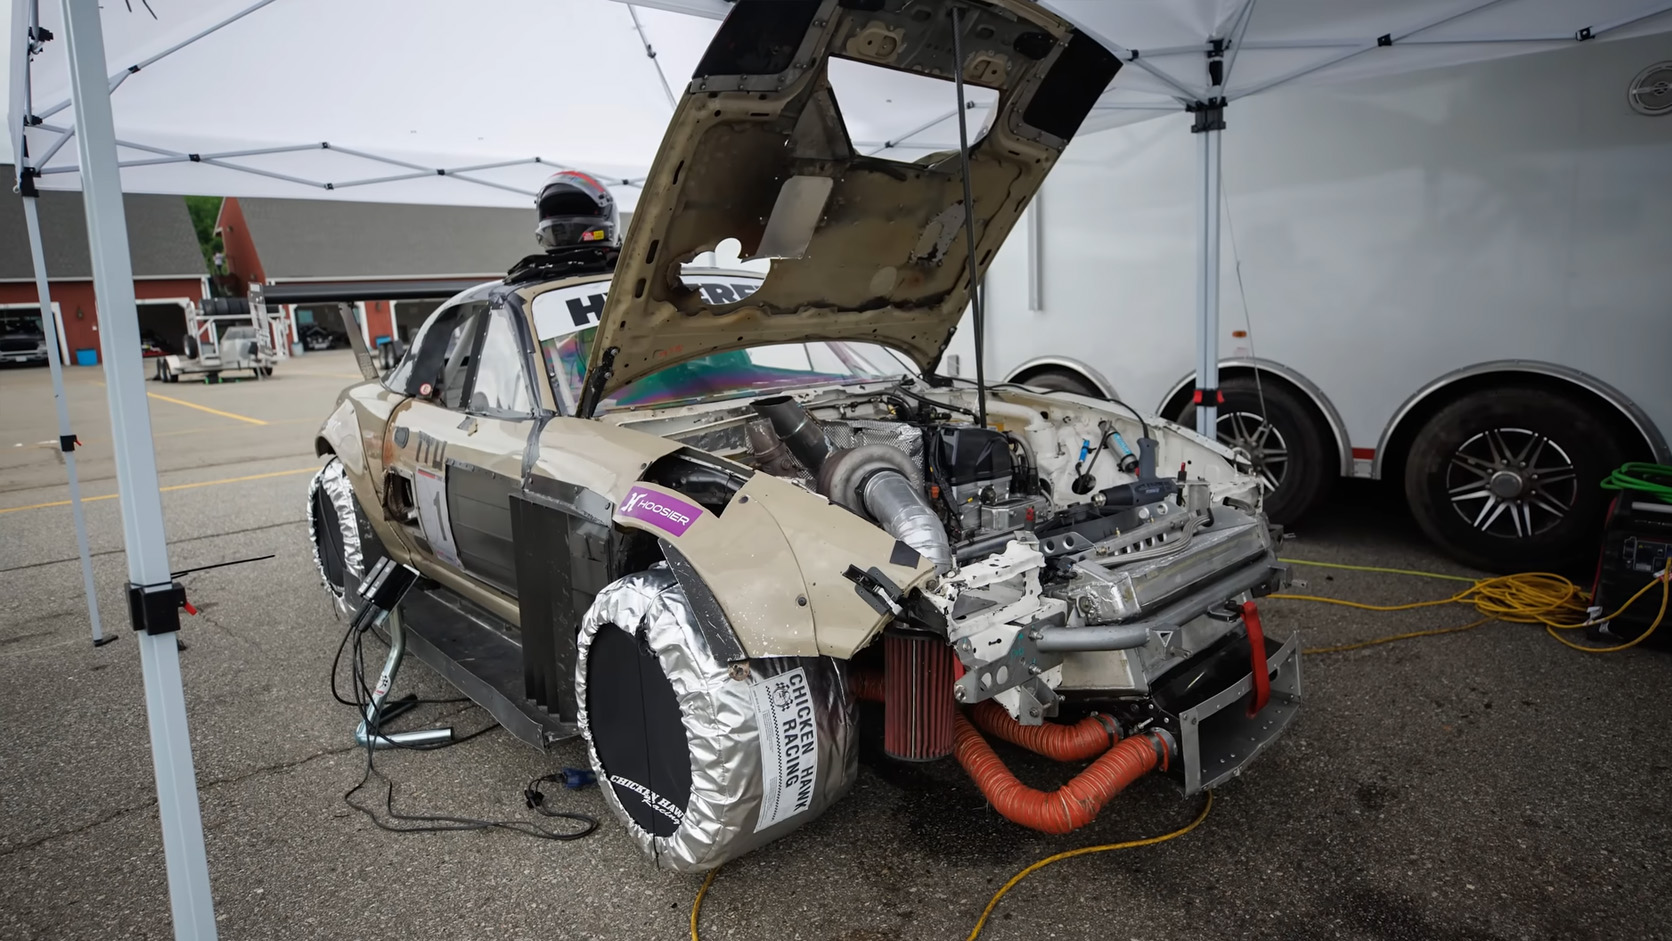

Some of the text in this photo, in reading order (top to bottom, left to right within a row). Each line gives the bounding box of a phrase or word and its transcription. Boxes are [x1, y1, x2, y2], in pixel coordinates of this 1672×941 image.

[565, 291, 608, 327] H
[637, 499, 690, 526] HOOSIER
[782, 718, 800, 789] RACING
[789, 673, 815, 812] CHICKEN HAWK
[657, 797, 685, 818] HAW
